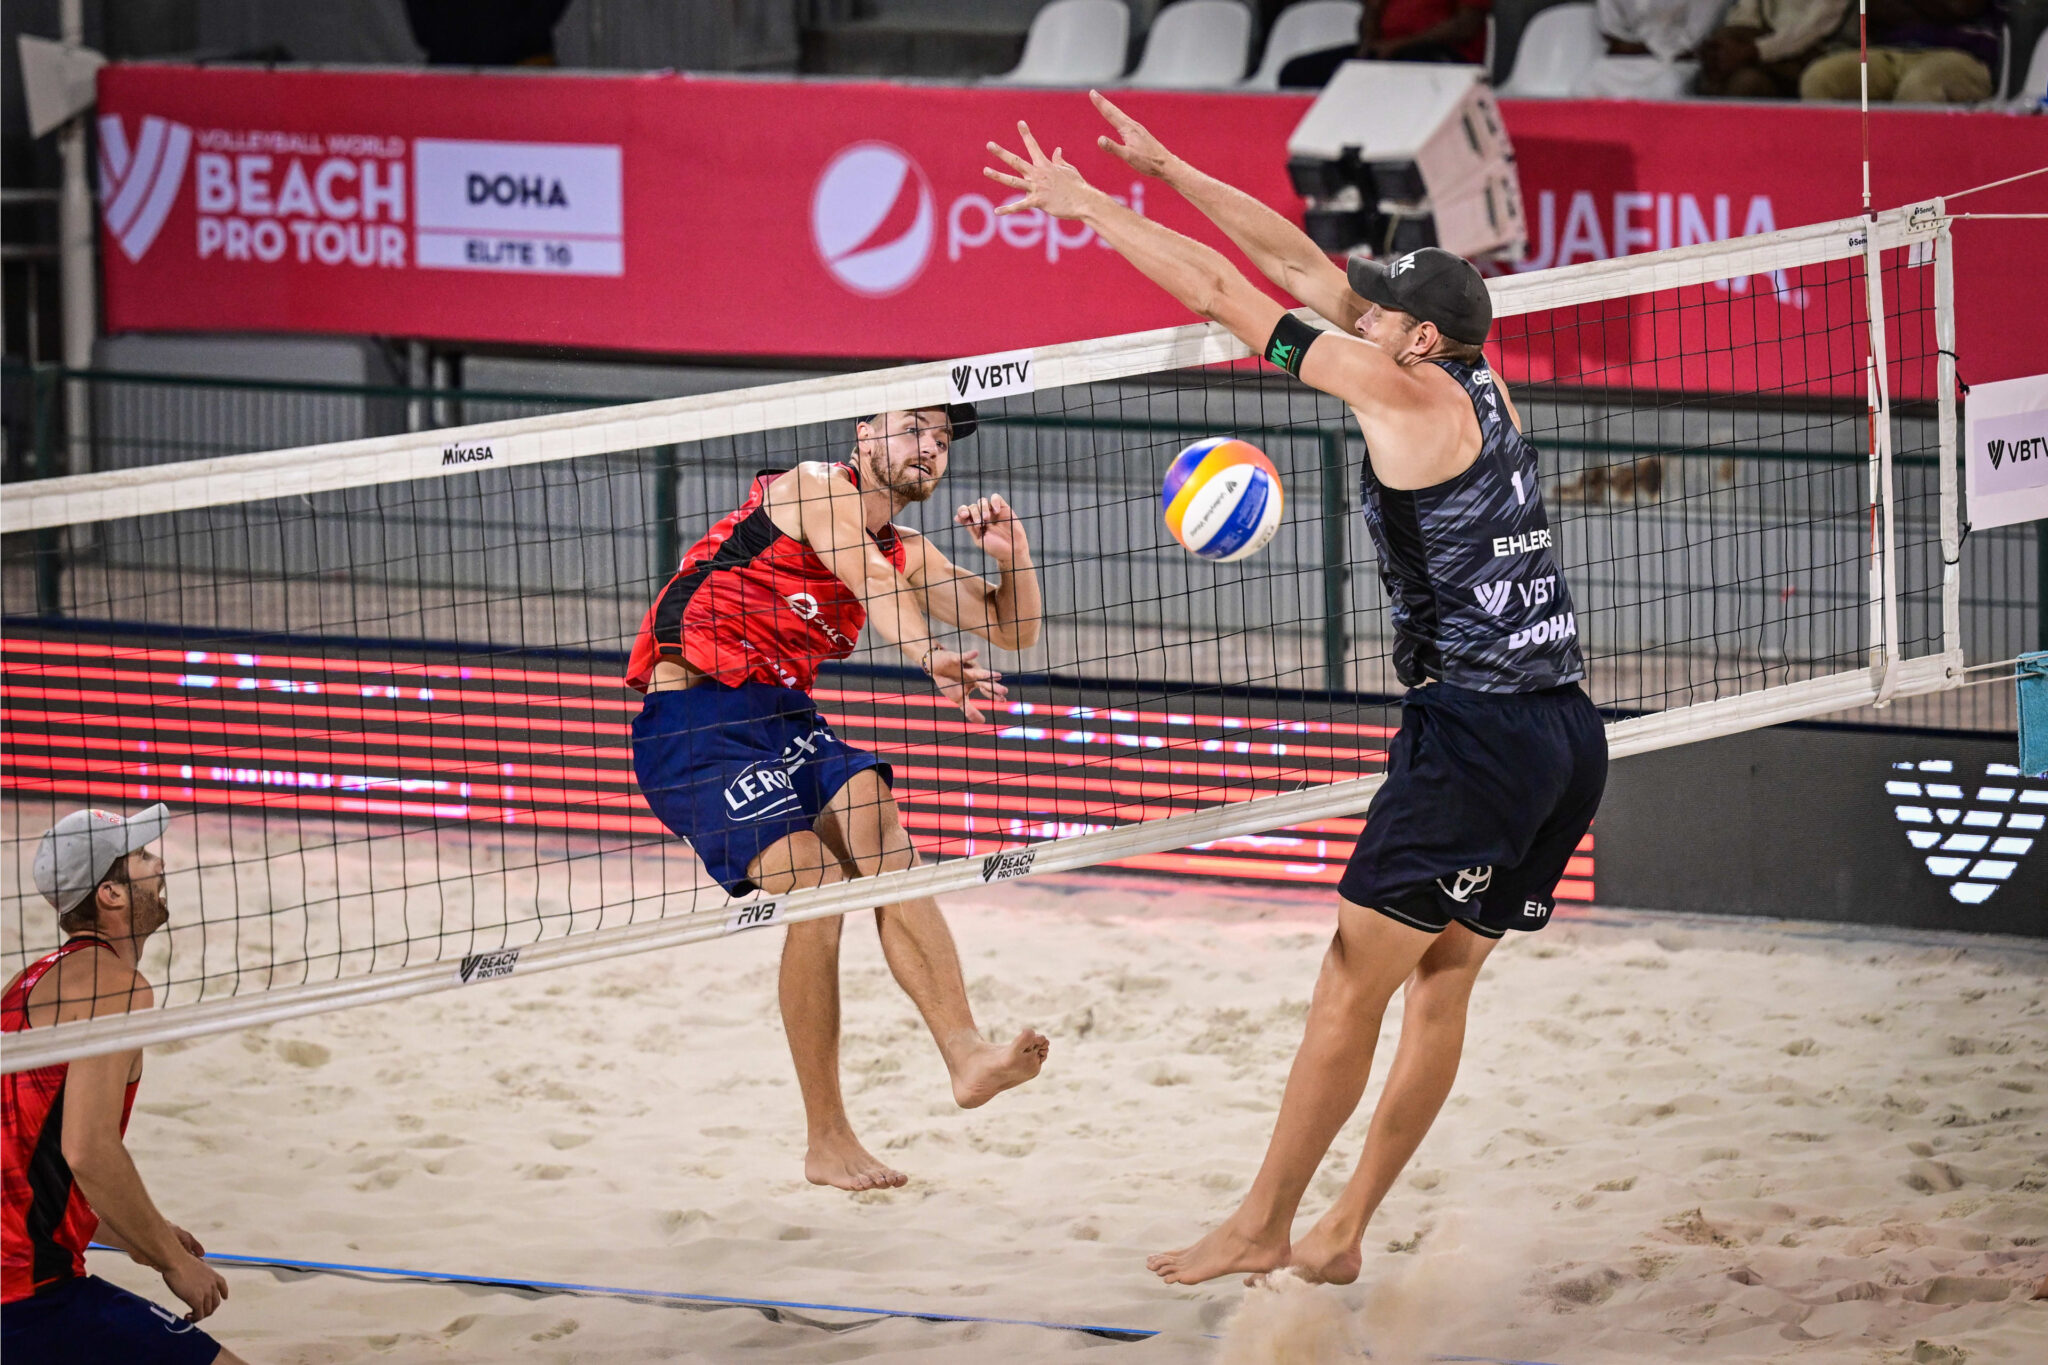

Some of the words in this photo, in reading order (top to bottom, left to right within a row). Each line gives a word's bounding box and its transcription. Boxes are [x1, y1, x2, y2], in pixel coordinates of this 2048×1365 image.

[196, 153, 406, 222] BEACH
[467, 173, 569, 208] DOHA
[197, 216, 287, 263] PRO
[290, 219, 407, 268] TOUR
[975, 360, 1030, 389] VBTV
[1511, 471, 1525, 505] 1
[1508, 611, 1576, 650] DOHA
[1000, 853, 1035, 870] BEACH
[479, 951, 519, 970] BEACH
